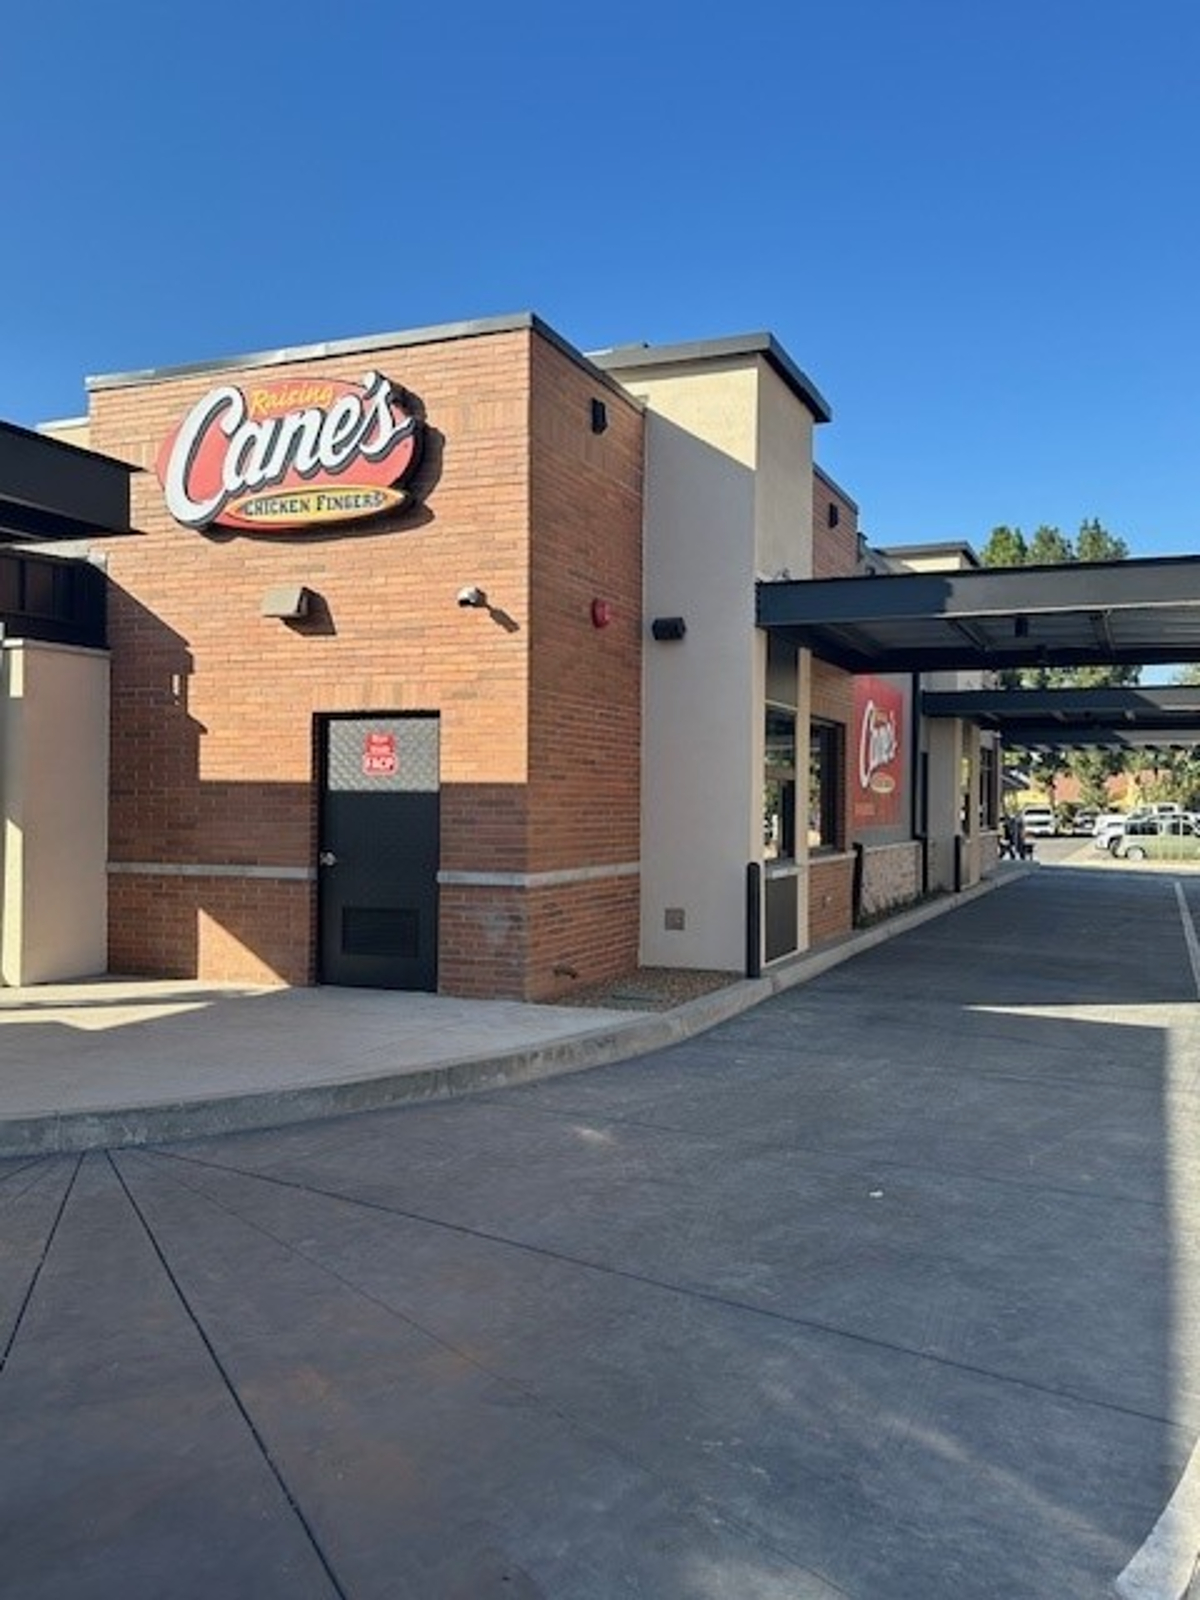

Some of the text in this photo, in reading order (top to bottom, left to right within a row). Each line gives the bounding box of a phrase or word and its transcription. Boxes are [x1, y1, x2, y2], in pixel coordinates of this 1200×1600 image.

[250, 384, 334, 413] Raising
[165, 370, 413, 524] Cane's
[244, 492, 383, 516] CHICKEN FINGERS
